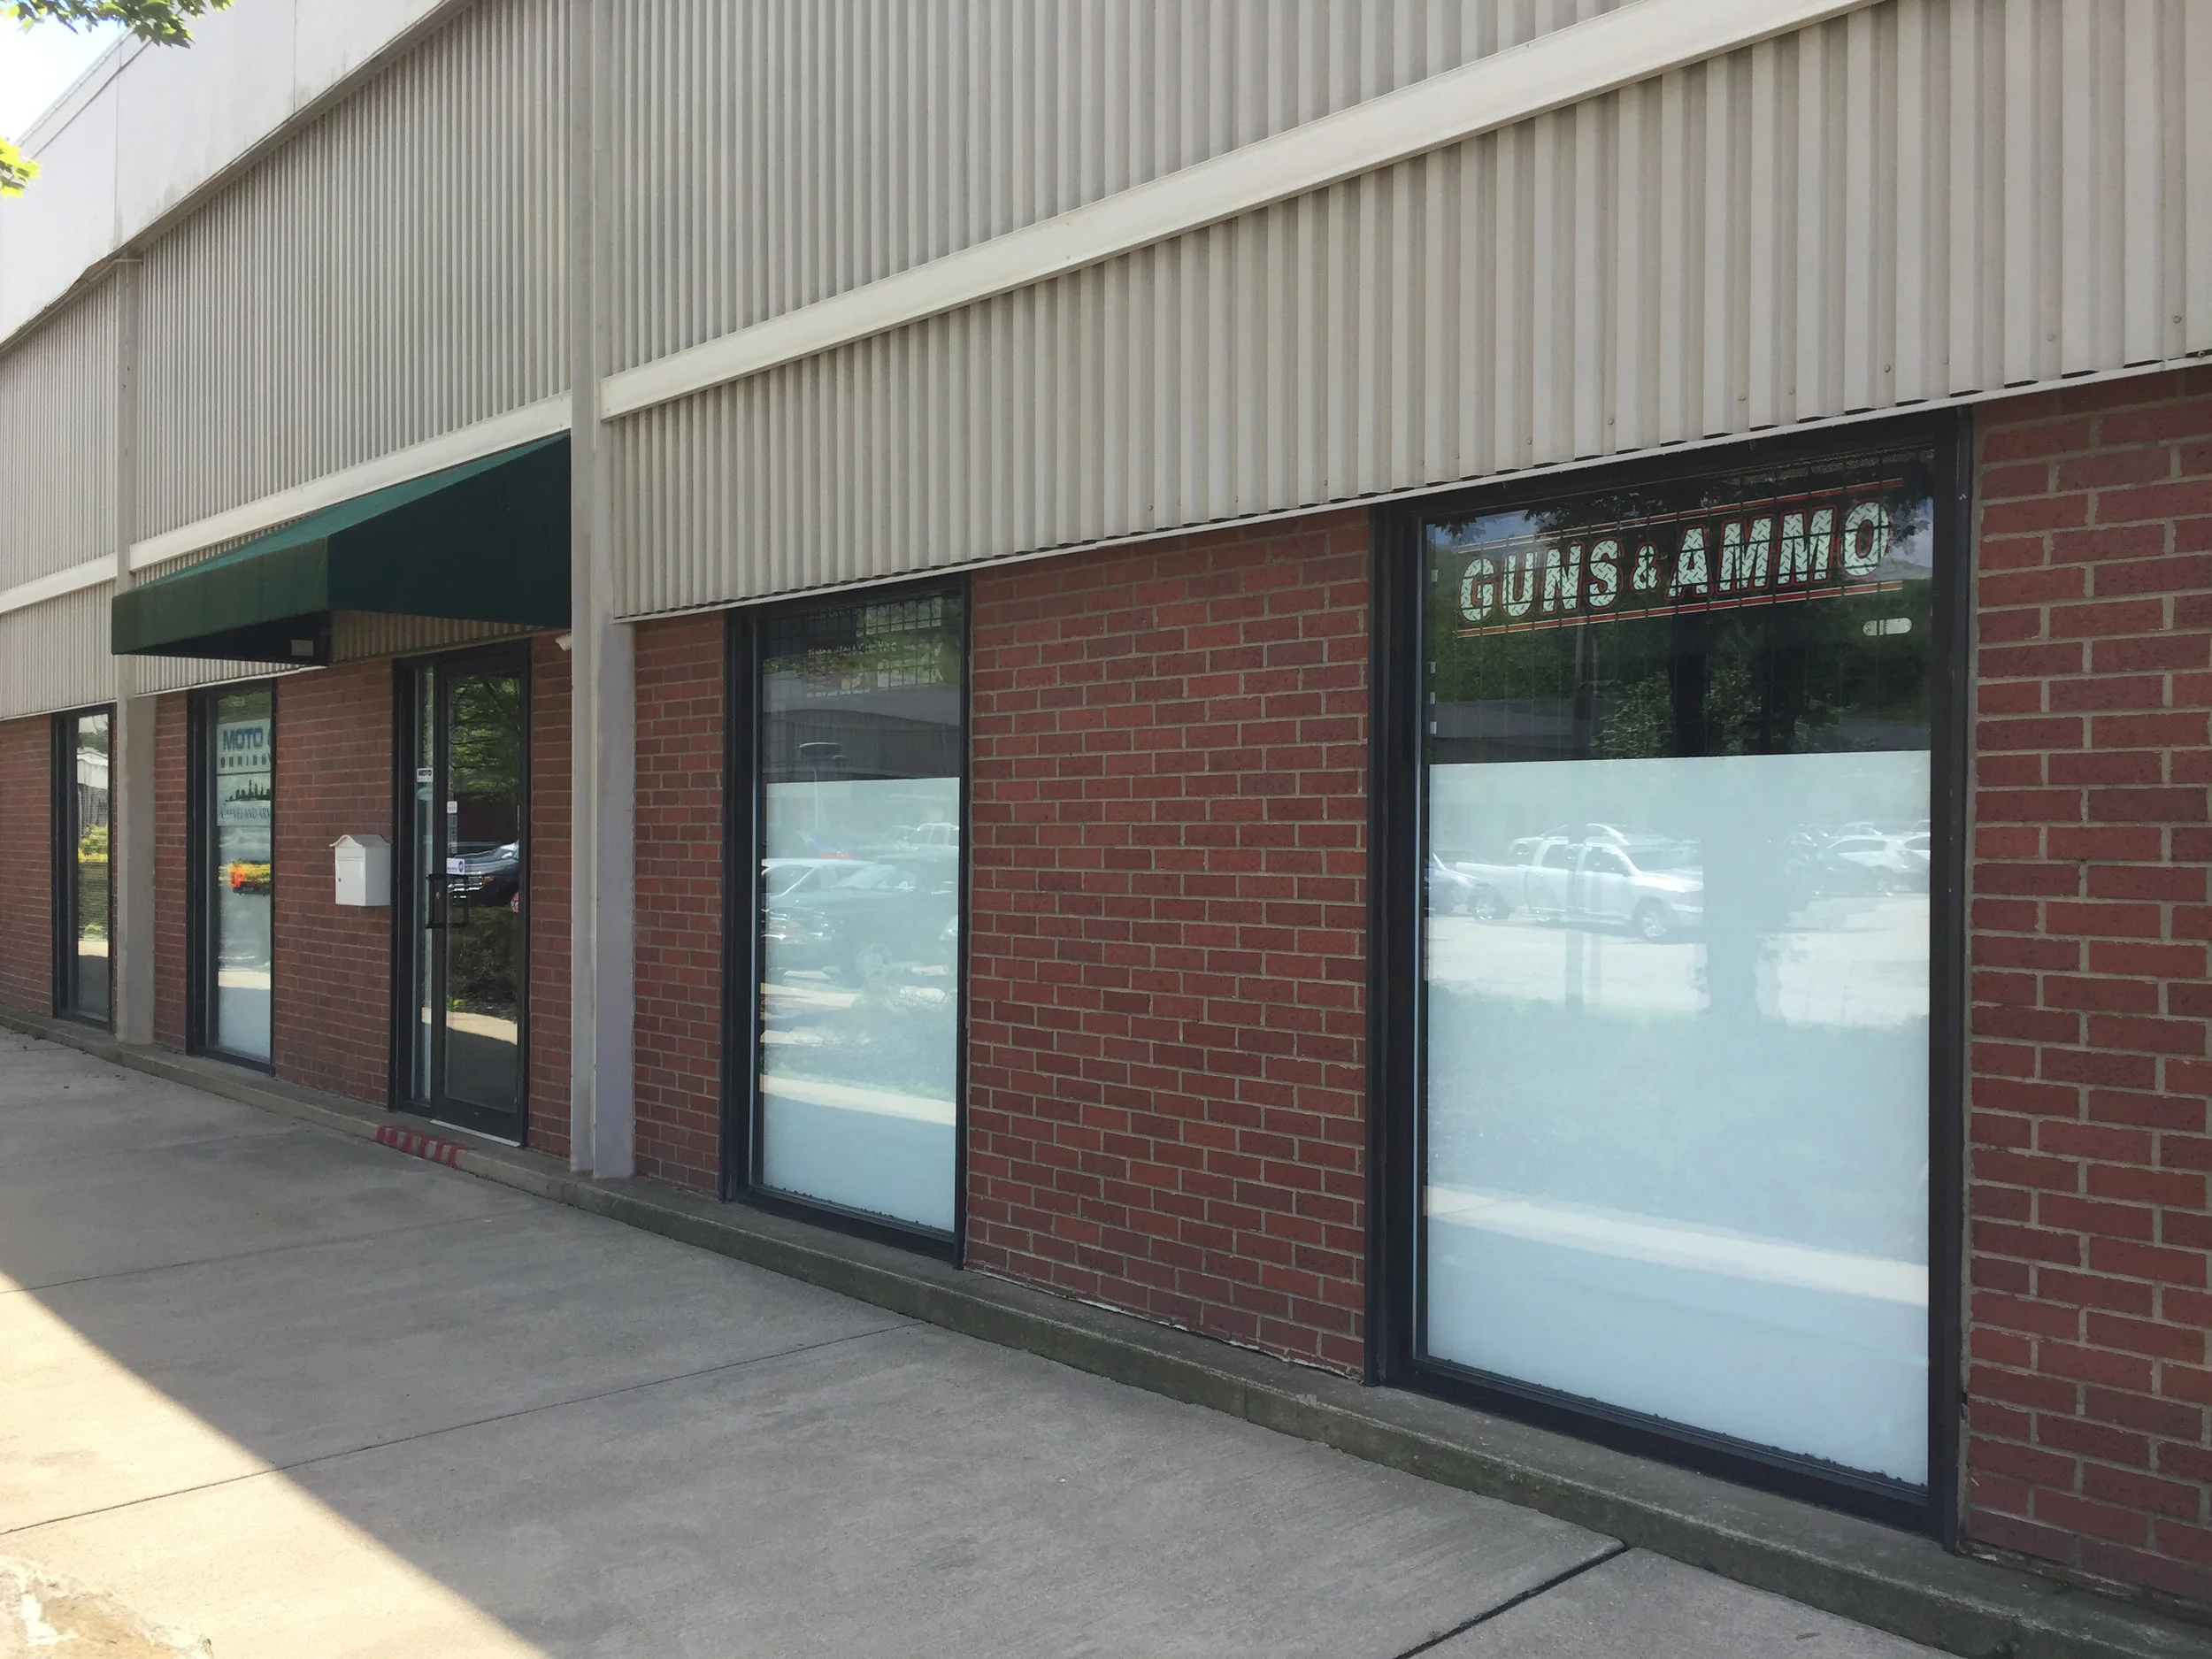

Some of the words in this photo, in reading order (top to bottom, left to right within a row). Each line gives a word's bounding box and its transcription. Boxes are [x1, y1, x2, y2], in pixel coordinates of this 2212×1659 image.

[1459, 538, 1621, 622] GUNS
[1632, 543, 1659, 592] &
[1668, 501, 1892, 599] AMMO
[222, 726, 264, 751] MOTO
